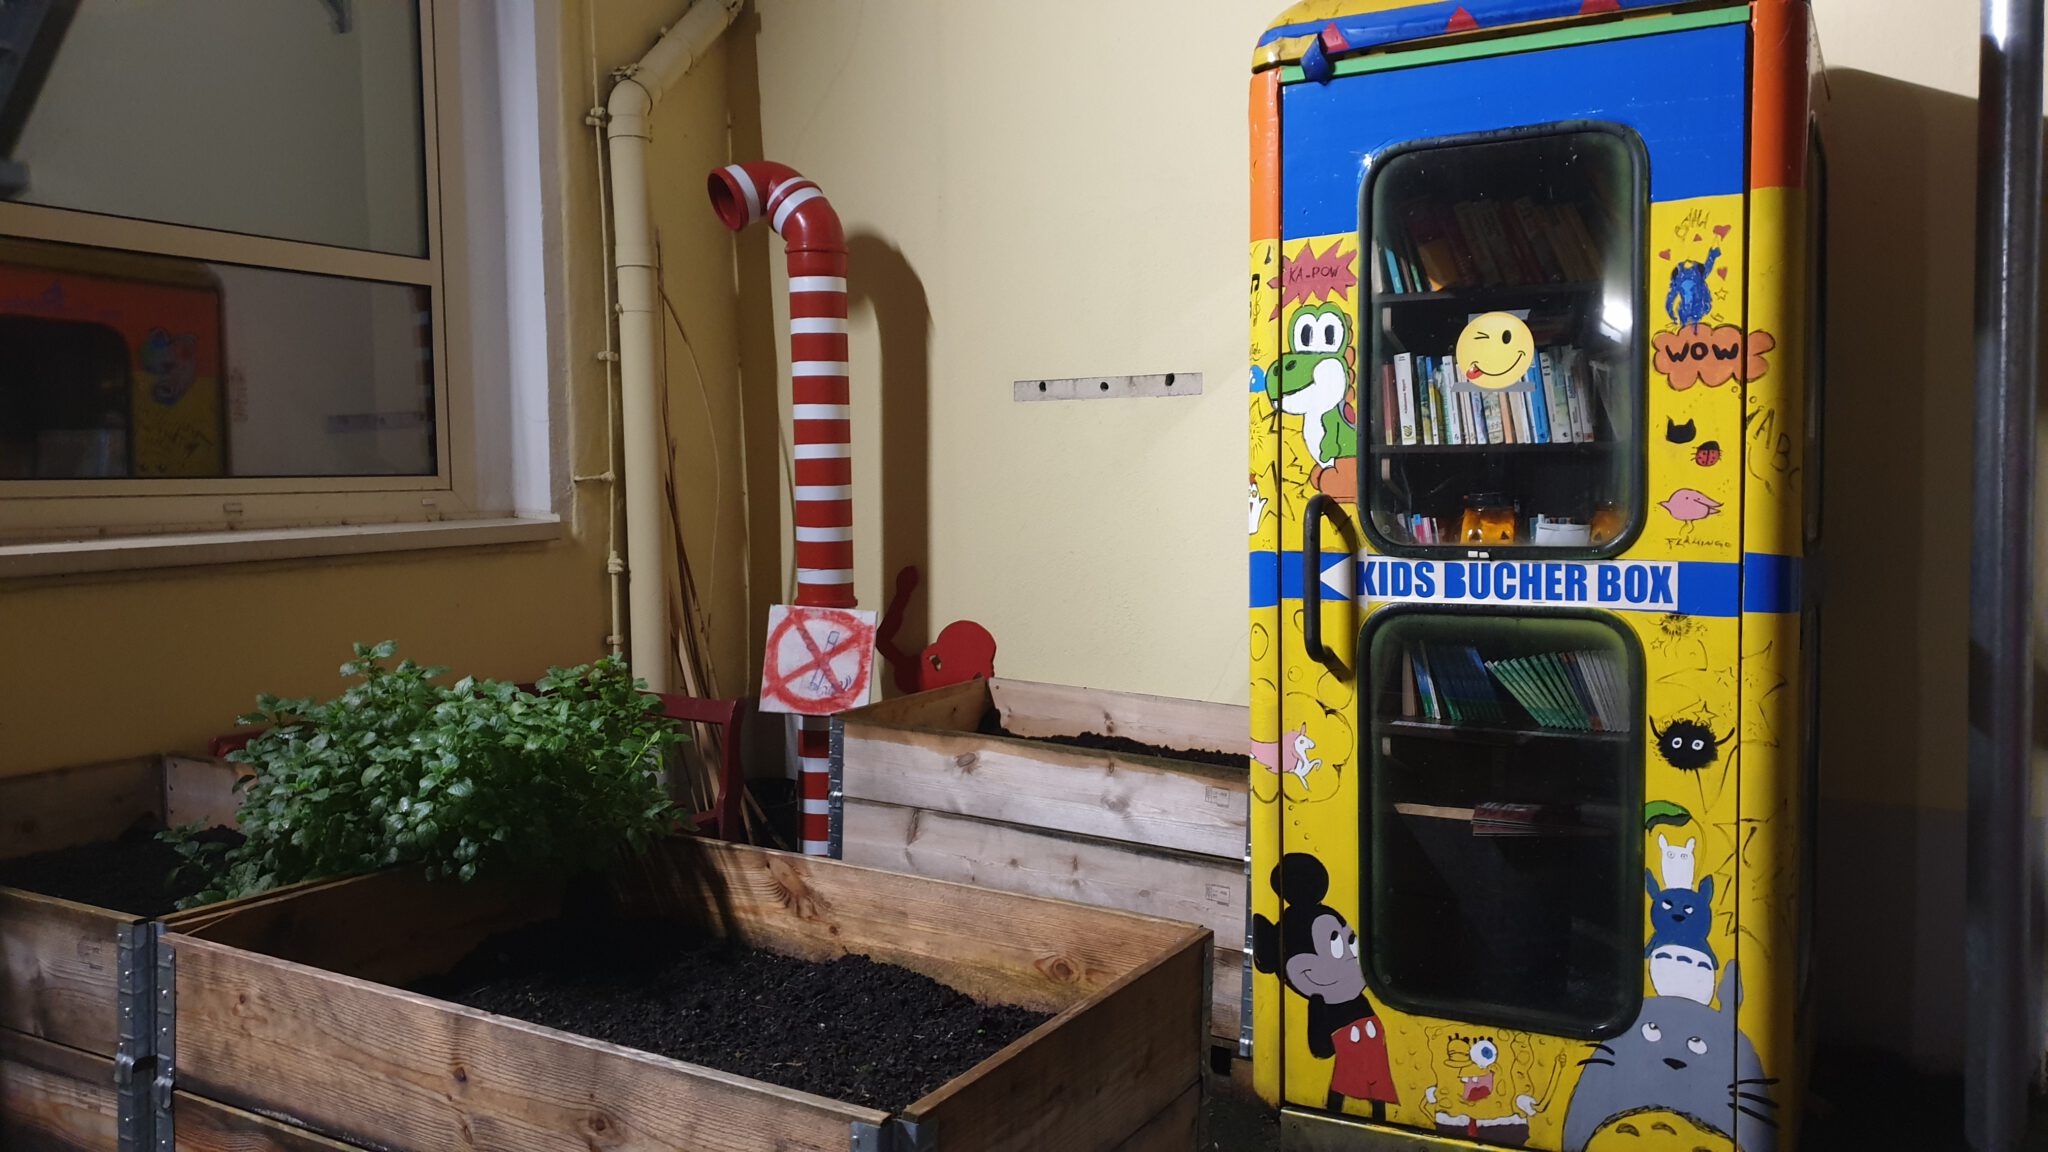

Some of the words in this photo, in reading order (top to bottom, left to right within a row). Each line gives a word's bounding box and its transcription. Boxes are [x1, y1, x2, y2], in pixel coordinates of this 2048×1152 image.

[1665, 341, 1739, 362] WOW
[1665, 535, 1731, 550] FLAMINGO
[1356, 560, 1435, 597] KIDS
[1598, 564, 1674, 604] BOX
